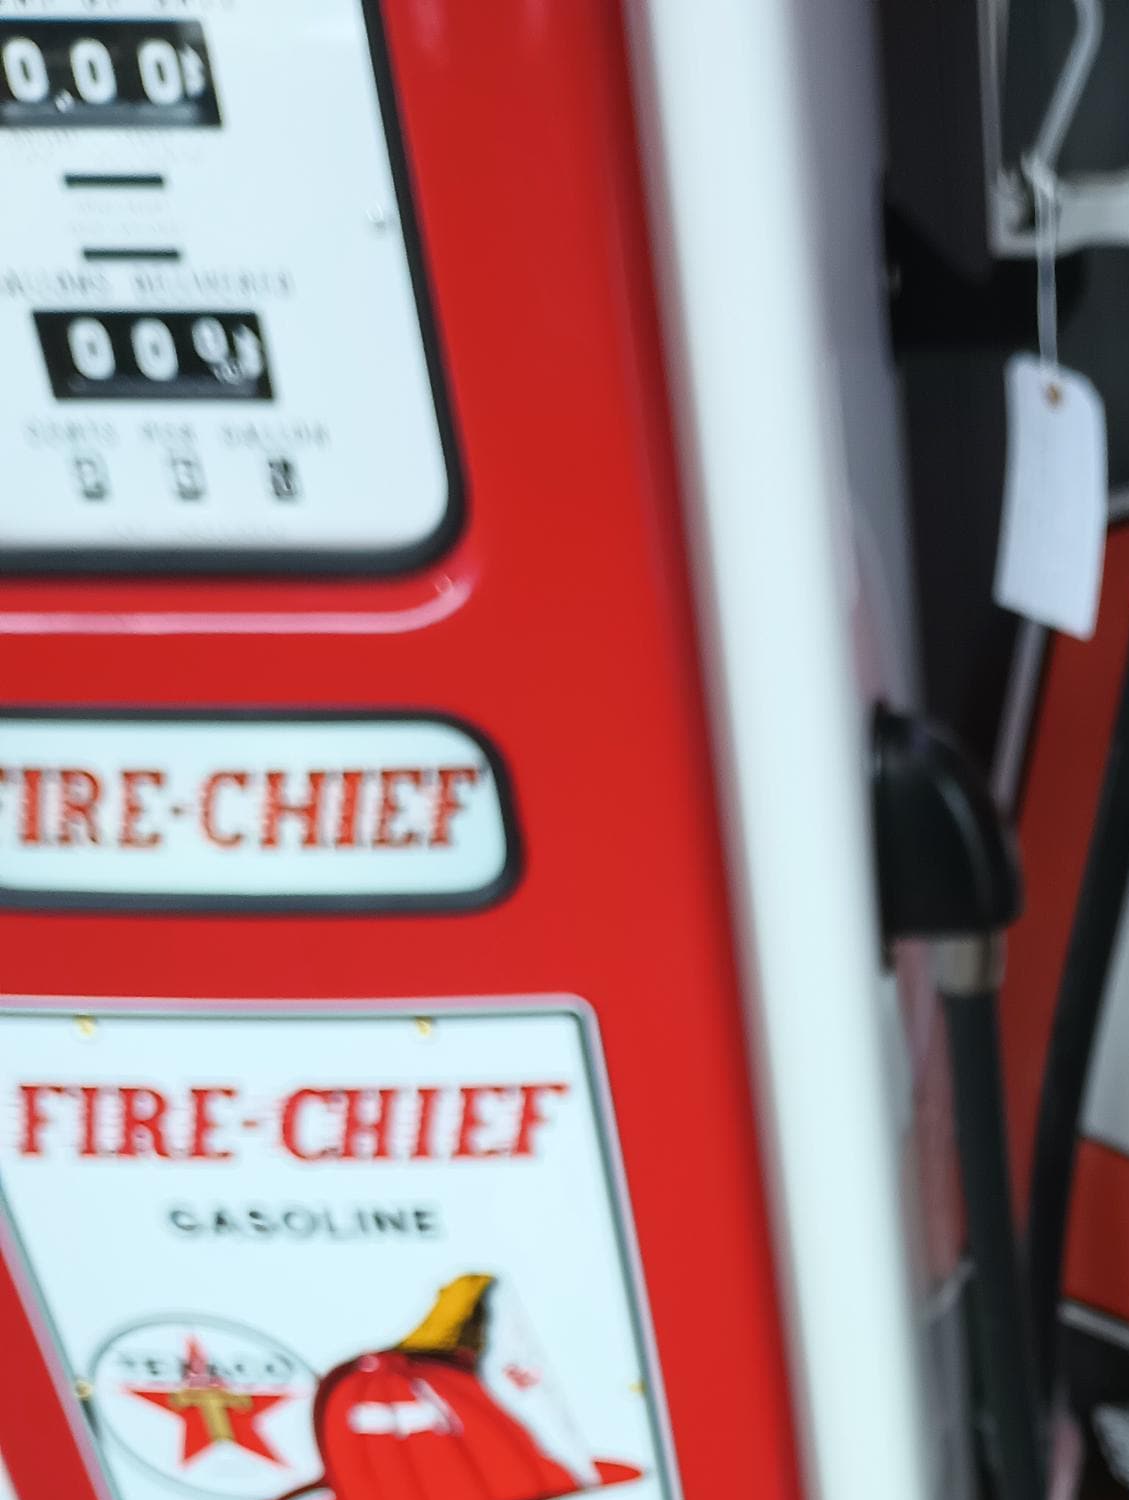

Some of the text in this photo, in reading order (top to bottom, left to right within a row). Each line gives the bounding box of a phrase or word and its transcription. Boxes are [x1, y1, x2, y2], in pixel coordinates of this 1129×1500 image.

[0, 767, 478, 850] IRE-CHIEF
[18, 1083, 569, 1161] FIRE-CHIEF
[168, 1208, 439, 1238] GASOLINE
